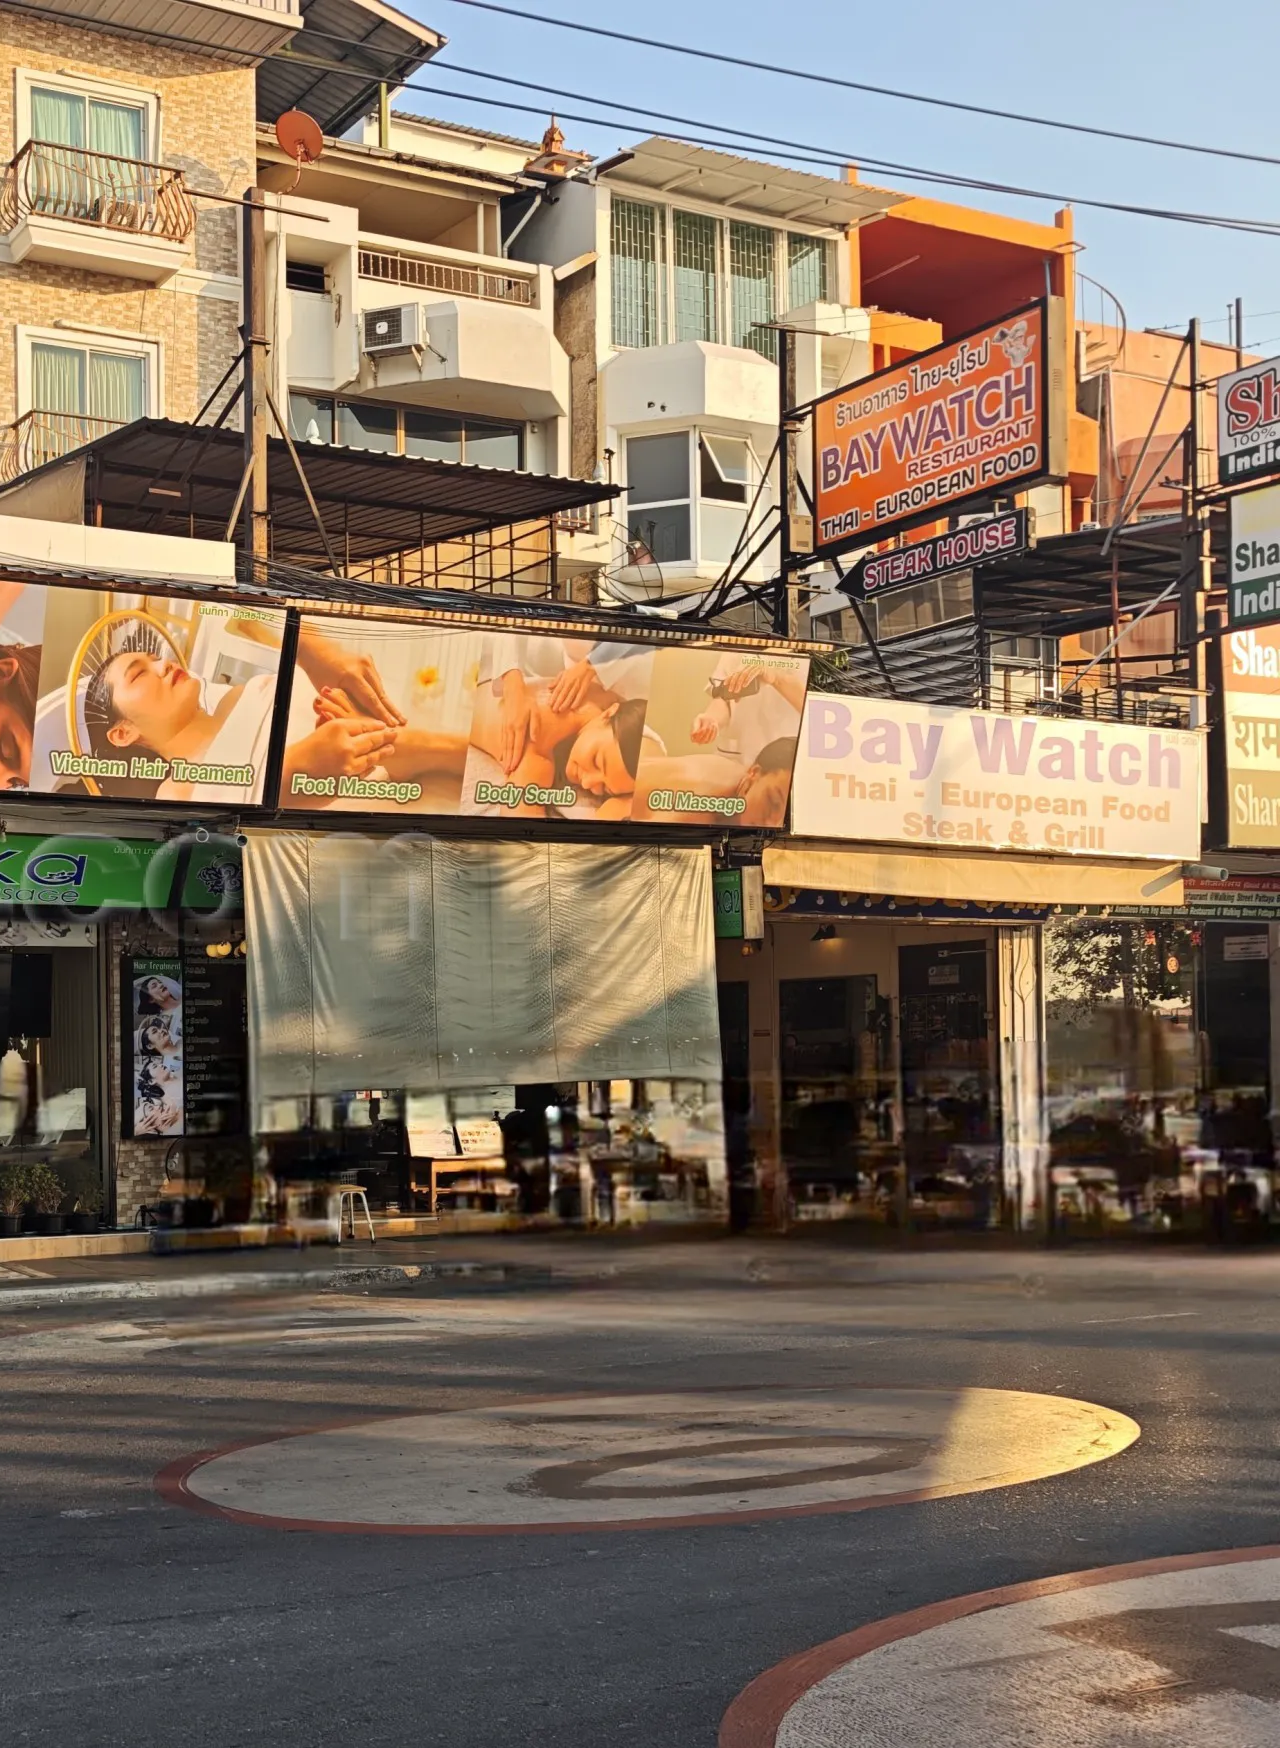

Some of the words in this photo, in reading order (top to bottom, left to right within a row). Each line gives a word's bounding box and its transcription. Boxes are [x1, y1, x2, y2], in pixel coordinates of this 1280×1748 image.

[837, 381, 907, 428] ร้านอาหาร
[911, 339, 990, 395] ไทย-ยุโรป
[821, 363, 1036, 492] BAYWATCH
[906, 418, 1035, 481] RESTAURANT
[1232, 426, 1277, 448] 100%
[820, 509, 861, 540] THAI
[876, 466, 975, 522] EUROPEAN
[980, 446, 1038, 484] FOOD
[863, 546, 934, 589] STEAK
[937, 518, 1017, 572] HOUSE
[808, 700, 944, 780] Bay
[970, 714, 1182, 789] Watch
[51, 752, 131, 777] Vietnam
[130, 756, 169, 778] Hair
[171, 758, 254, 785] Treament
[291, 773, 335, 796] Foot
[338, 776, 421, 801] Massage
[474, 782, 521, 806] Body
[524, 783, 576, 807] Scrub
[649, 790, 675, 809] Oil
[677, 791, 745, 814] Massage
[826, 771, 897, 803] Thai
[941, 782, 1088, 819] European
[1102, 796, 1171, 824] Food
[903, 812, 992, 844] Steak
[1009, 819, 1029, 846] &
[1044, 820, 1105, 850] Grill
[133, 961, 147, 970] Hair
[149, 961, 181, 970] Treatment
